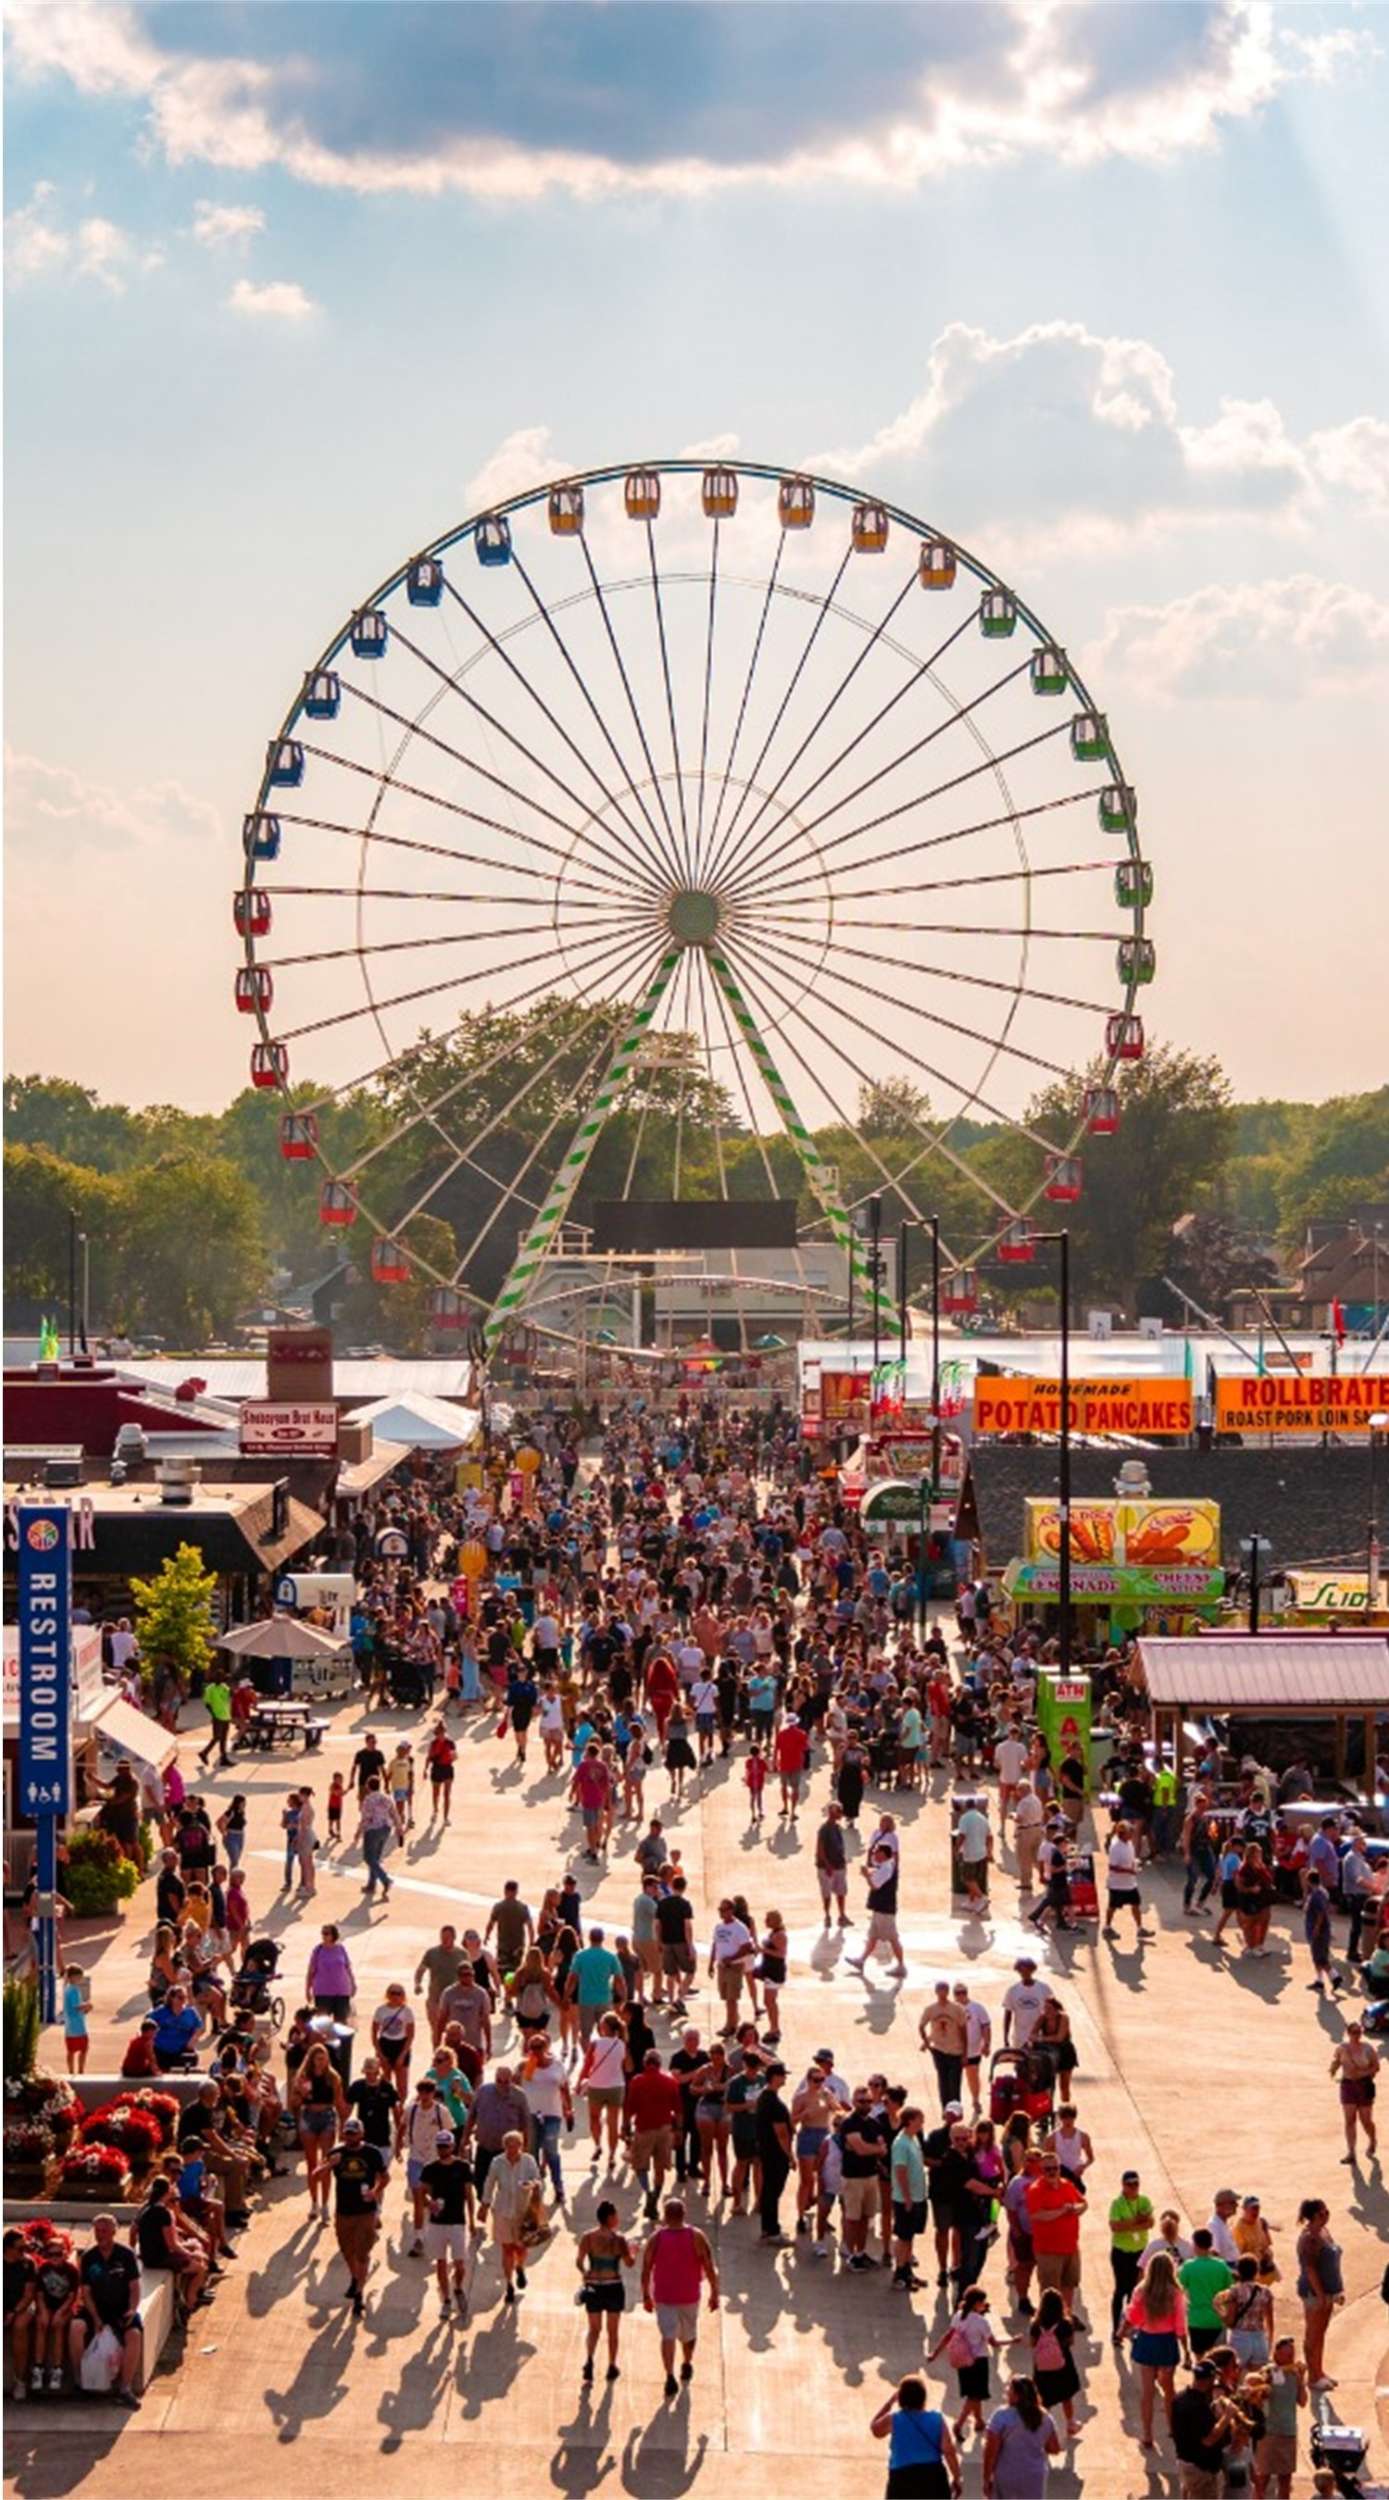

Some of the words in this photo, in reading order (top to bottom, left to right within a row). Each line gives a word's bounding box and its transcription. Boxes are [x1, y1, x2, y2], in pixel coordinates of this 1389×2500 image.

[1033, 1383, 1132, 1396] HOEMADE
[978, 1401, 1078, 1429] POTATO
[1085, 1402, 1191, 1429] PANCAKES
[1226, 1410, 1271, 1427] ROAST
[1275, 1410, 1313, 1426] PORK
[1318, 1409, 1349, 1426] LOIN
[30, 1573, 57, 1760] RESTROOM
[1057, 1683, 1084, 1697] ATM
